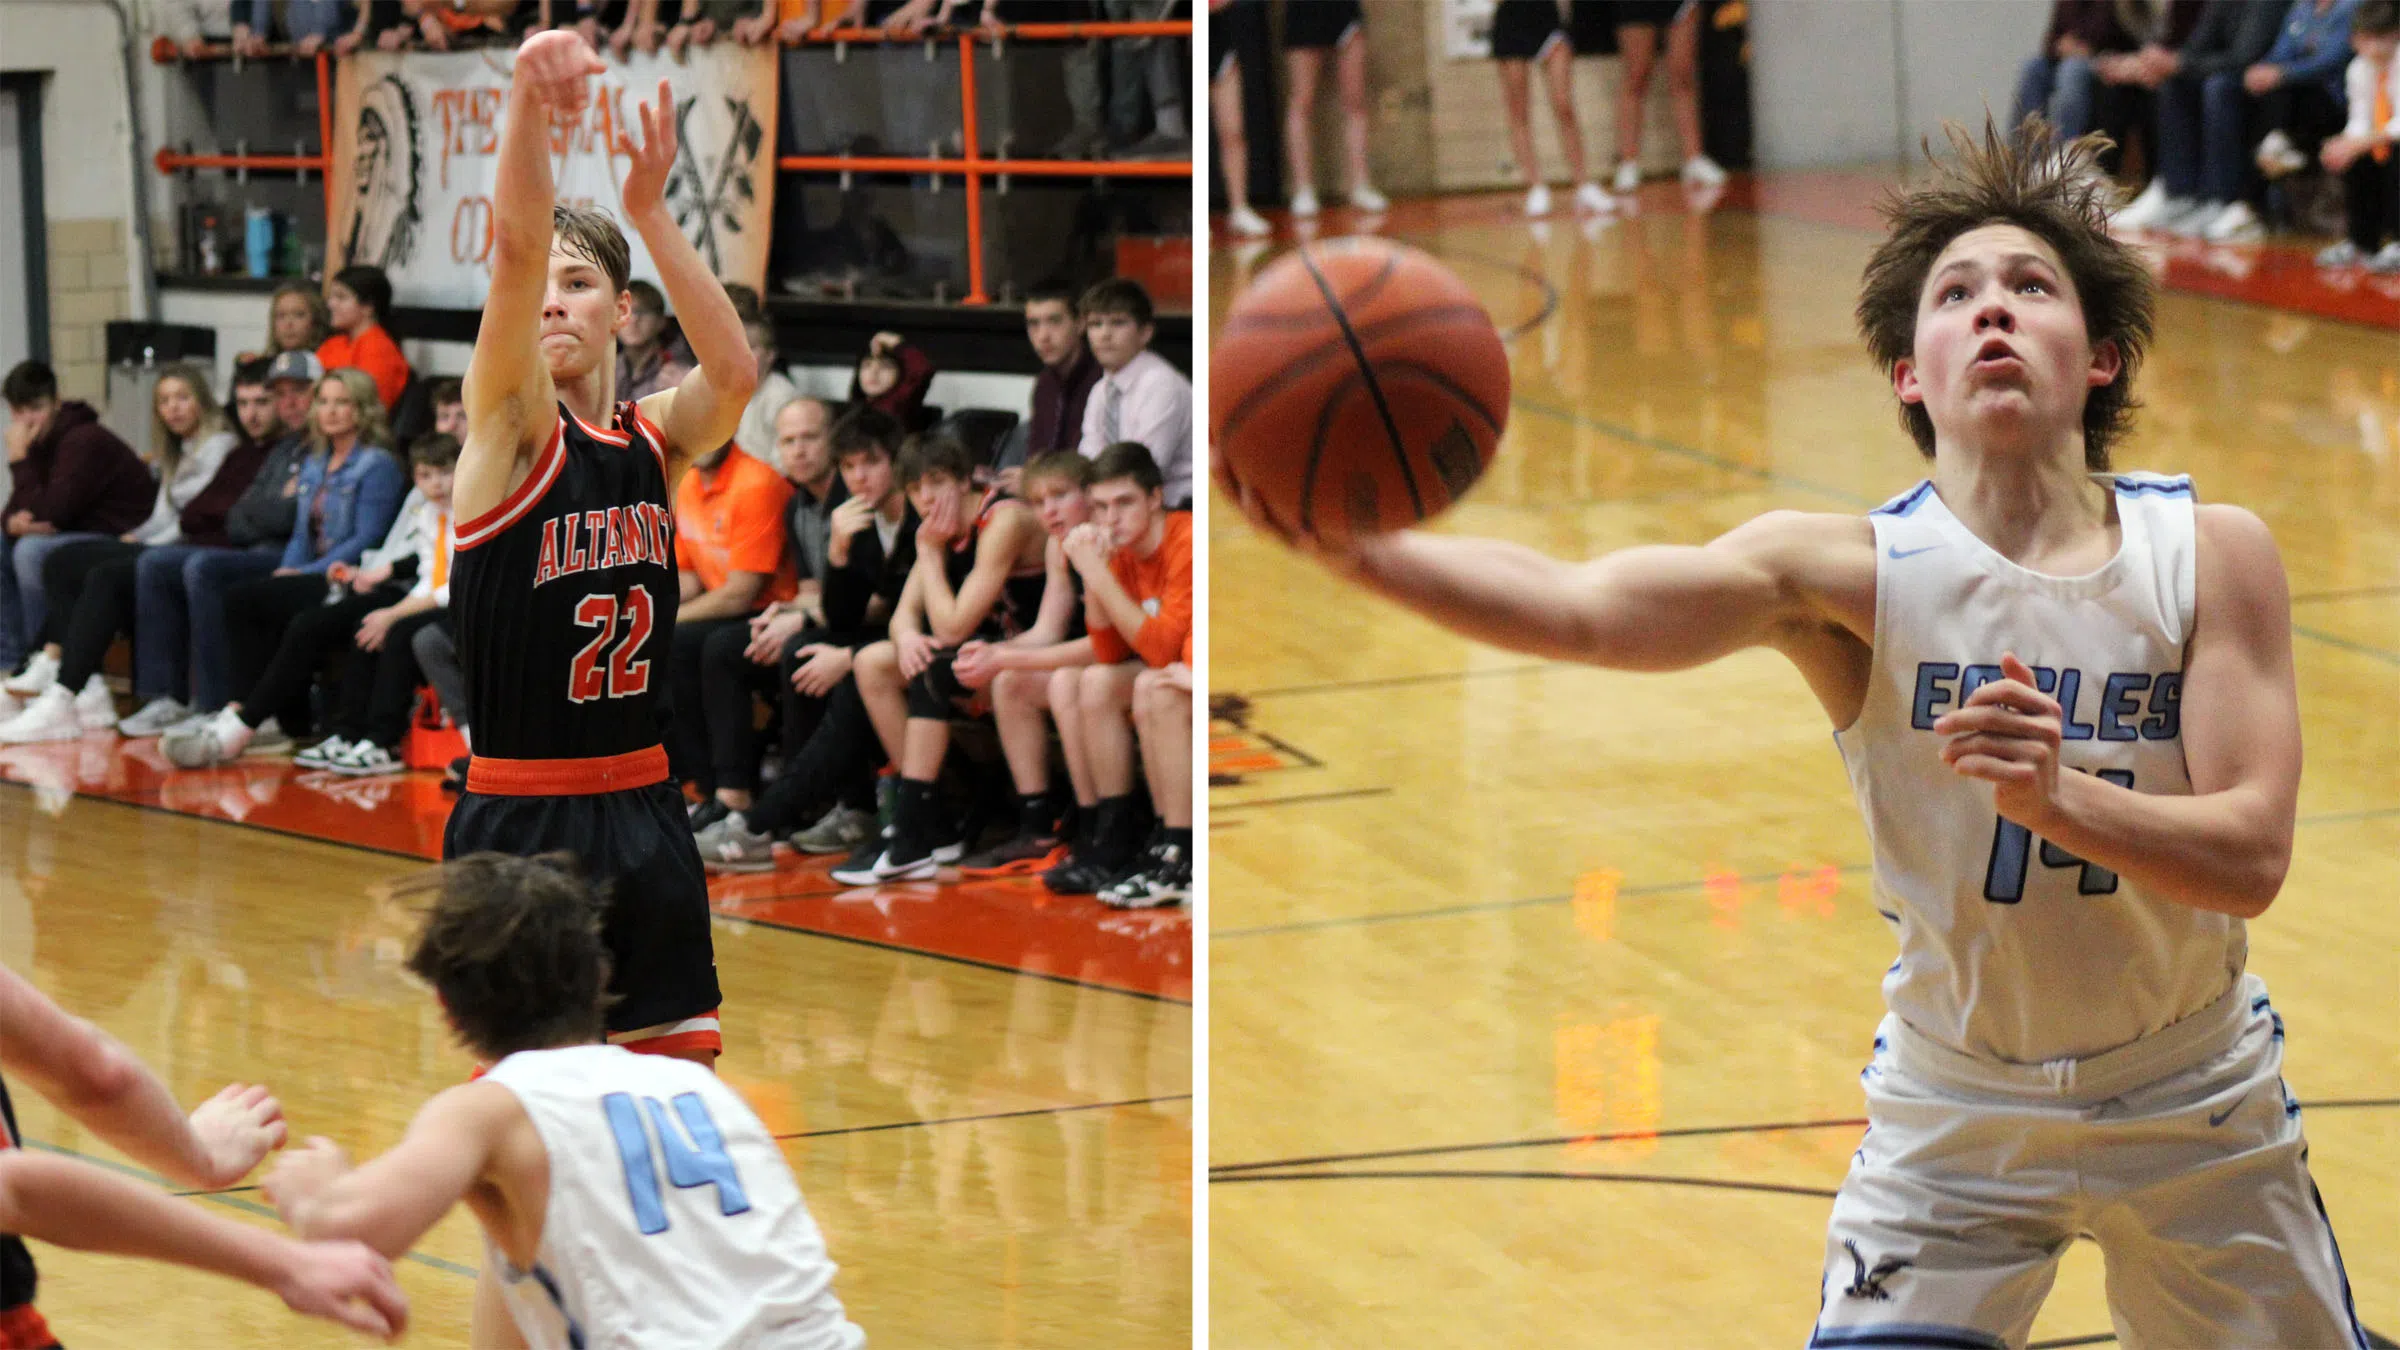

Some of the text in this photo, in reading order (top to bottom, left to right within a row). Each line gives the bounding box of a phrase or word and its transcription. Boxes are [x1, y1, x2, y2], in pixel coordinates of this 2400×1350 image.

[568, 584, 653, 703] 22
[1911, 661, 2182, 741] ELES
[602, 1091, 751, 1235] 14
